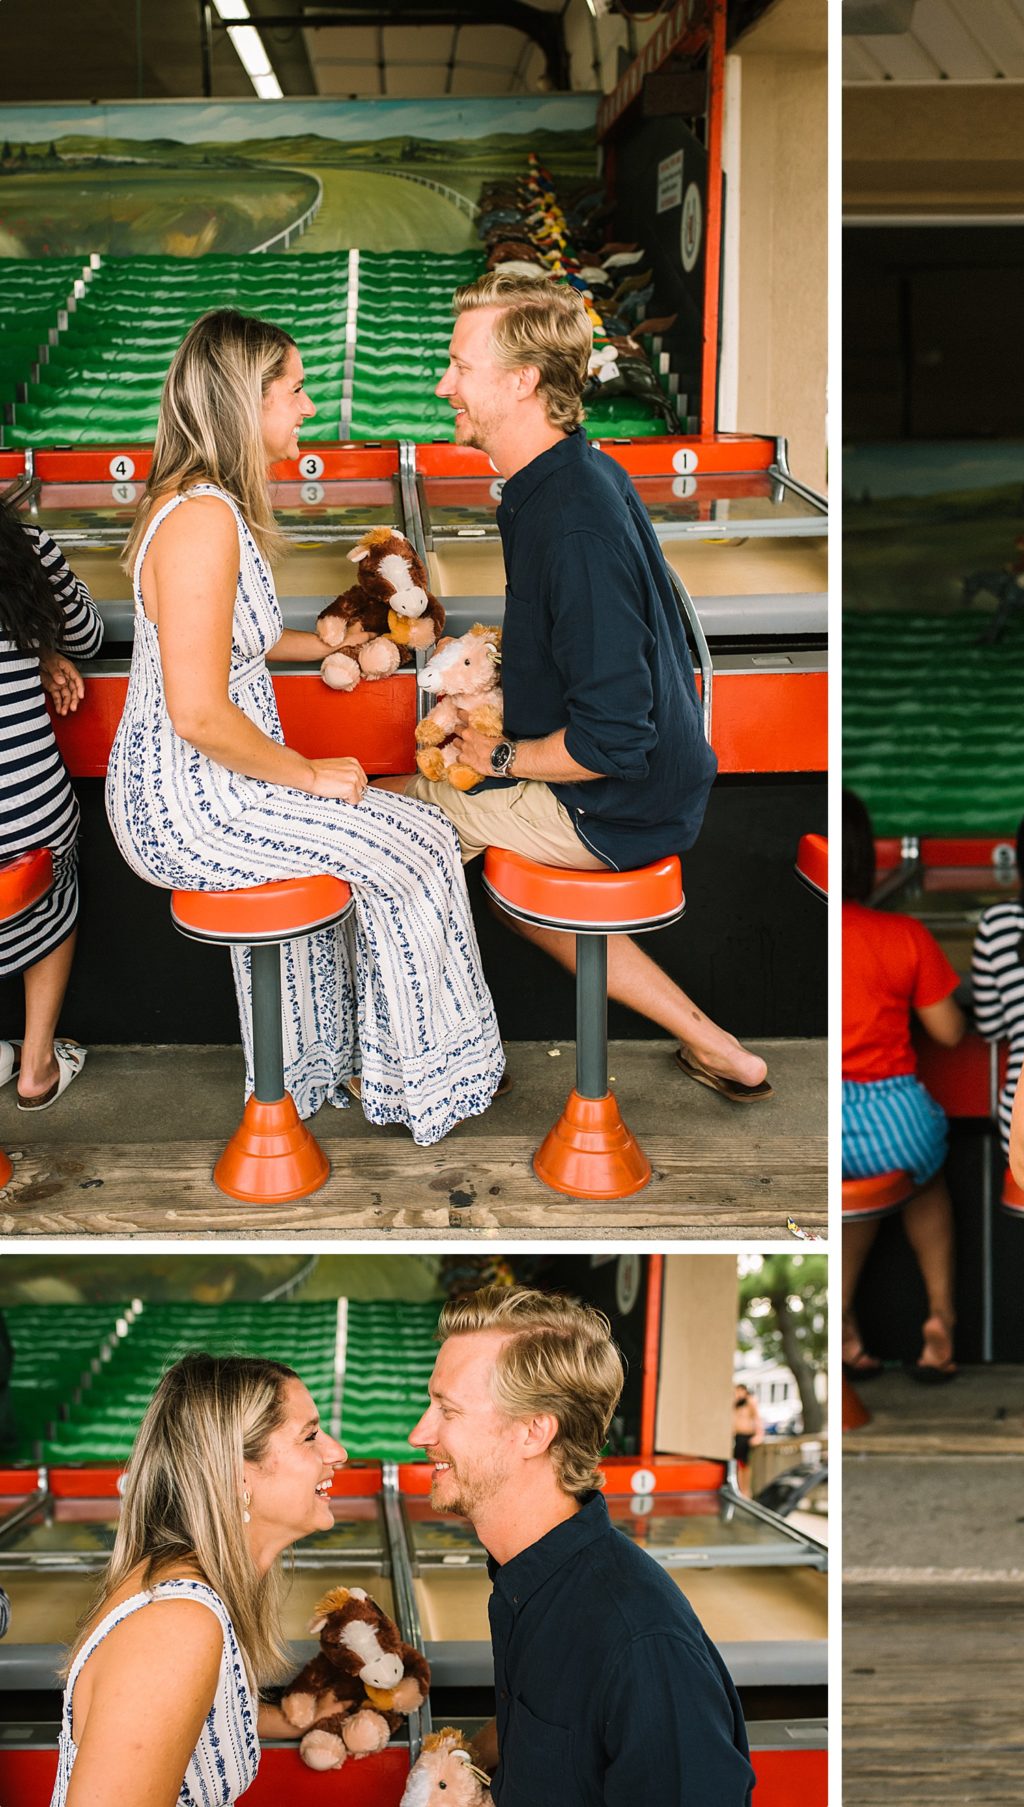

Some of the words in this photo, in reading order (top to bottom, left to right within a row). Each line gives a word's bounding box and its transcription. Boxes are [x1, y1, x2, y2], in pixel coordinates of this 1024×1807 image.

[115, 460, 127, 476] 4
[306, 459, 317, 474] 3
[682, 452, 688, 470] 1
